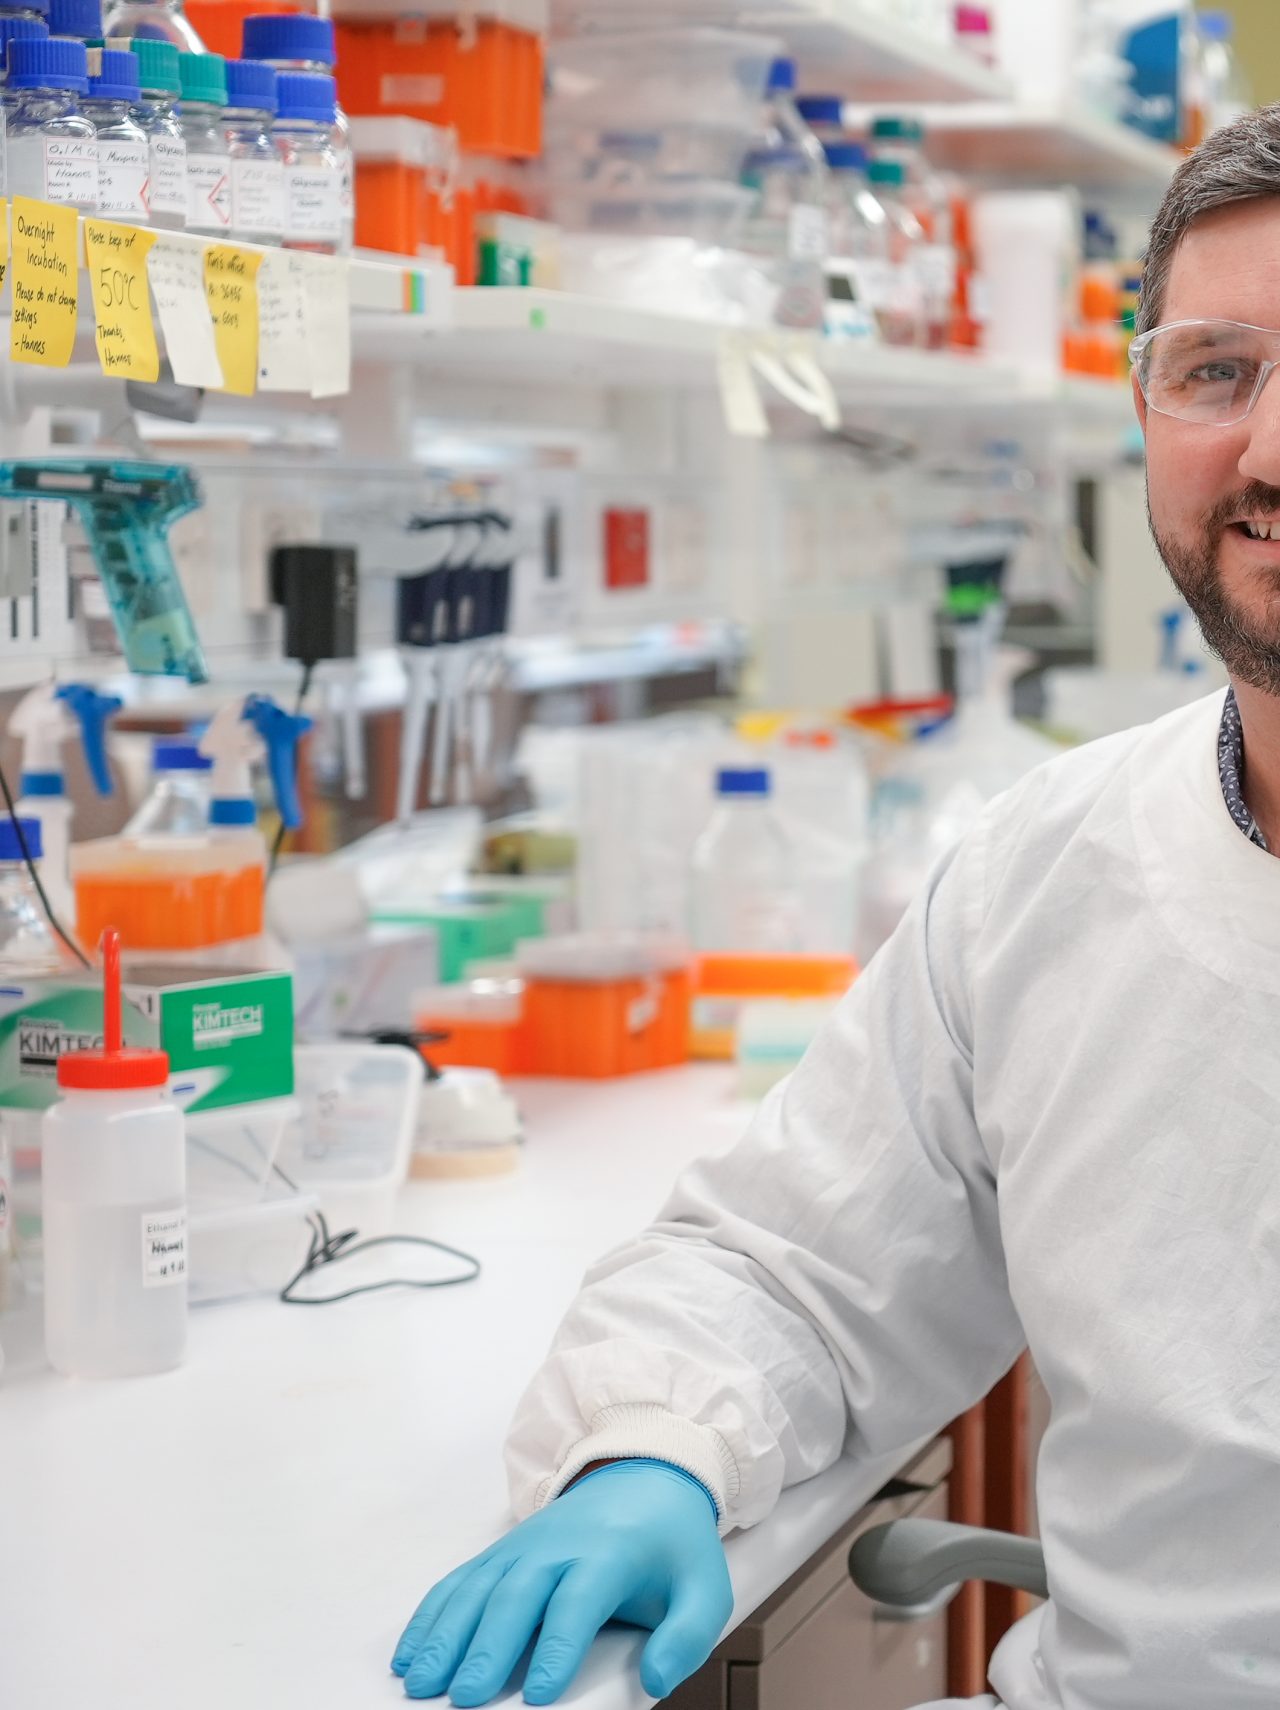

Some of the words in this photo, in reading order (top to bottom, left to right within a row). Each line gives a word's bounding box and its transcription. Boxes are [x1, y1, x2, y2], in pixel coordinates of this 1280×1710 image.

[18, 216, 54, 249] Overnight
[27, 248, 67, 277] Incubation
[16, 281, 33, 302] Please
[37, 286, 44, 301] do
[47, 286, 57, 303] not
[101, 267, 139, 311] 50°C
[15, 307, 37, 330] settings
[193, 1004, 262, 1031] KIMTECH
